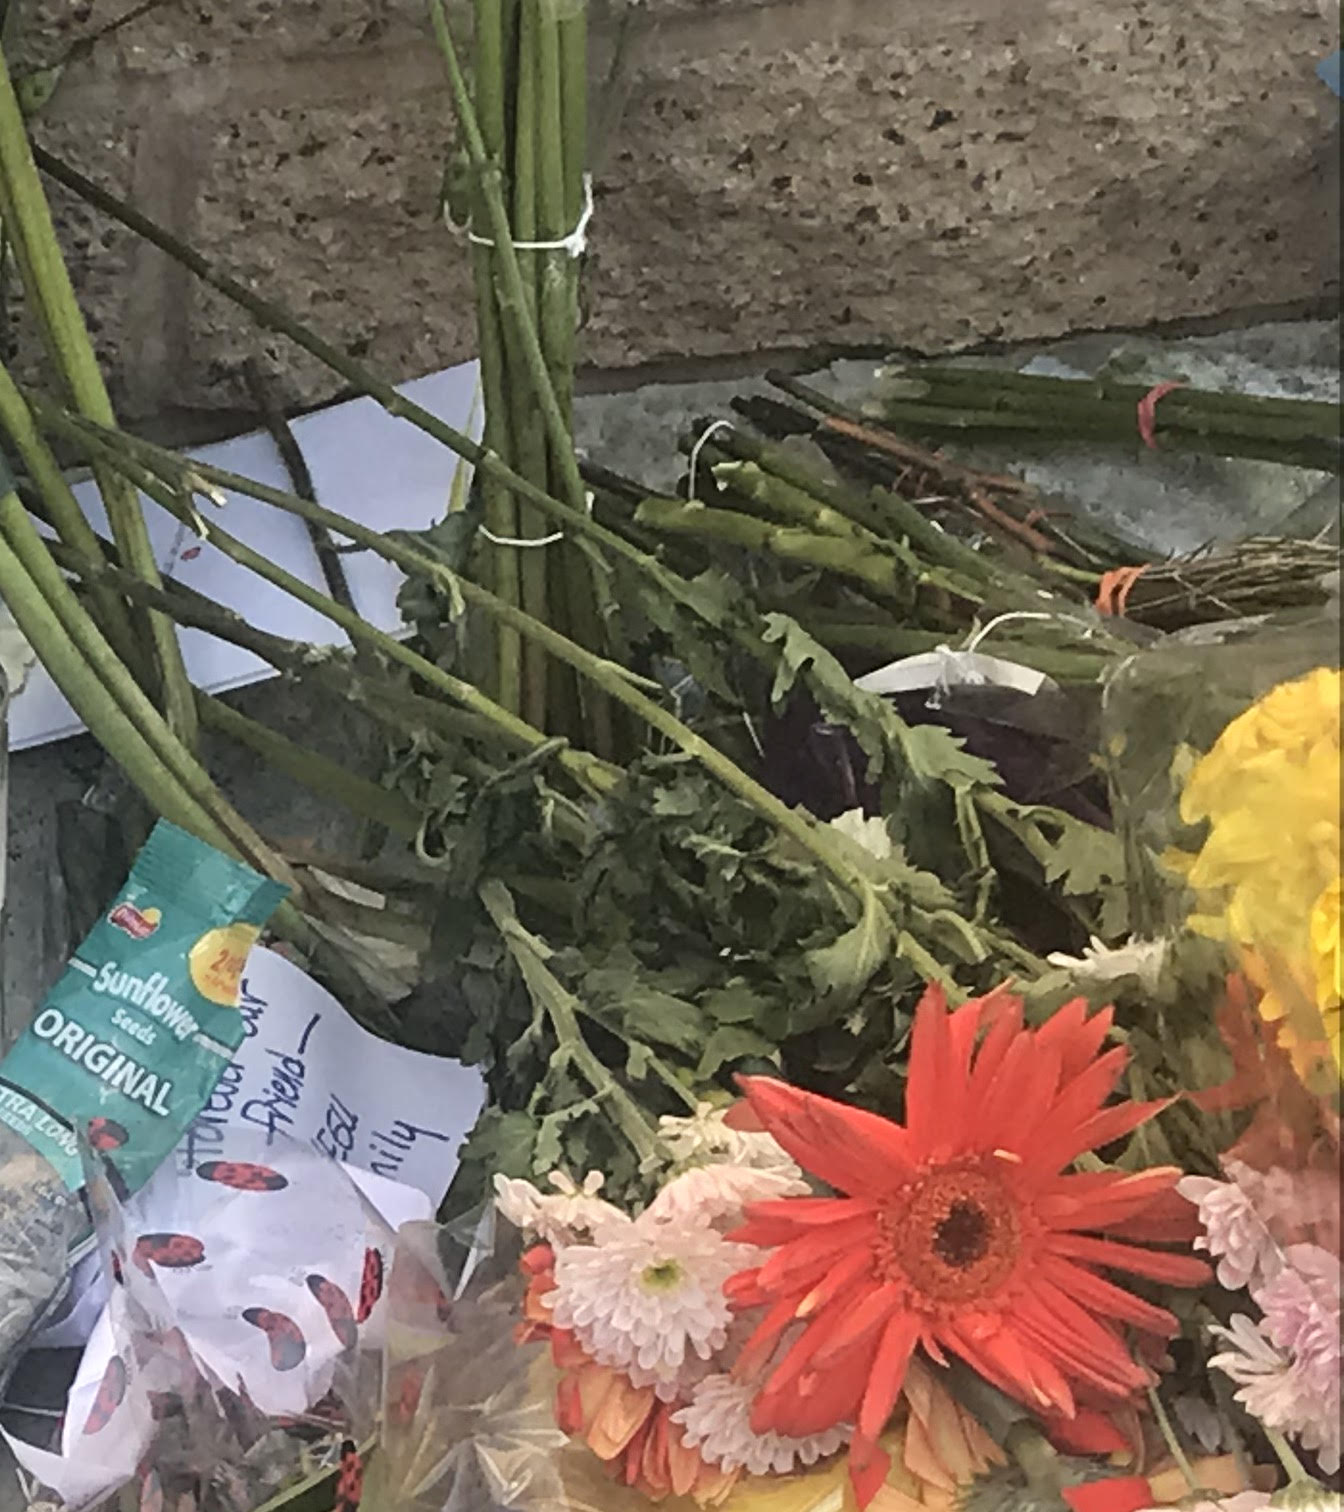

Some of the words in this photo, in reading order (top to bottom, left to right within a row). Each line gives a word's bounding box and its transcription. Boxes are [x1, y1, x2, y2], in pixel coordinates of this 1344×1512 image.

[93, 960, 199, 1041] Sunflower
[110, 1008, 158, 1046] Seeds
[31, 1007, 175, 1118] ORIGINAL
[37, 1112, 80, 1157] LONG
